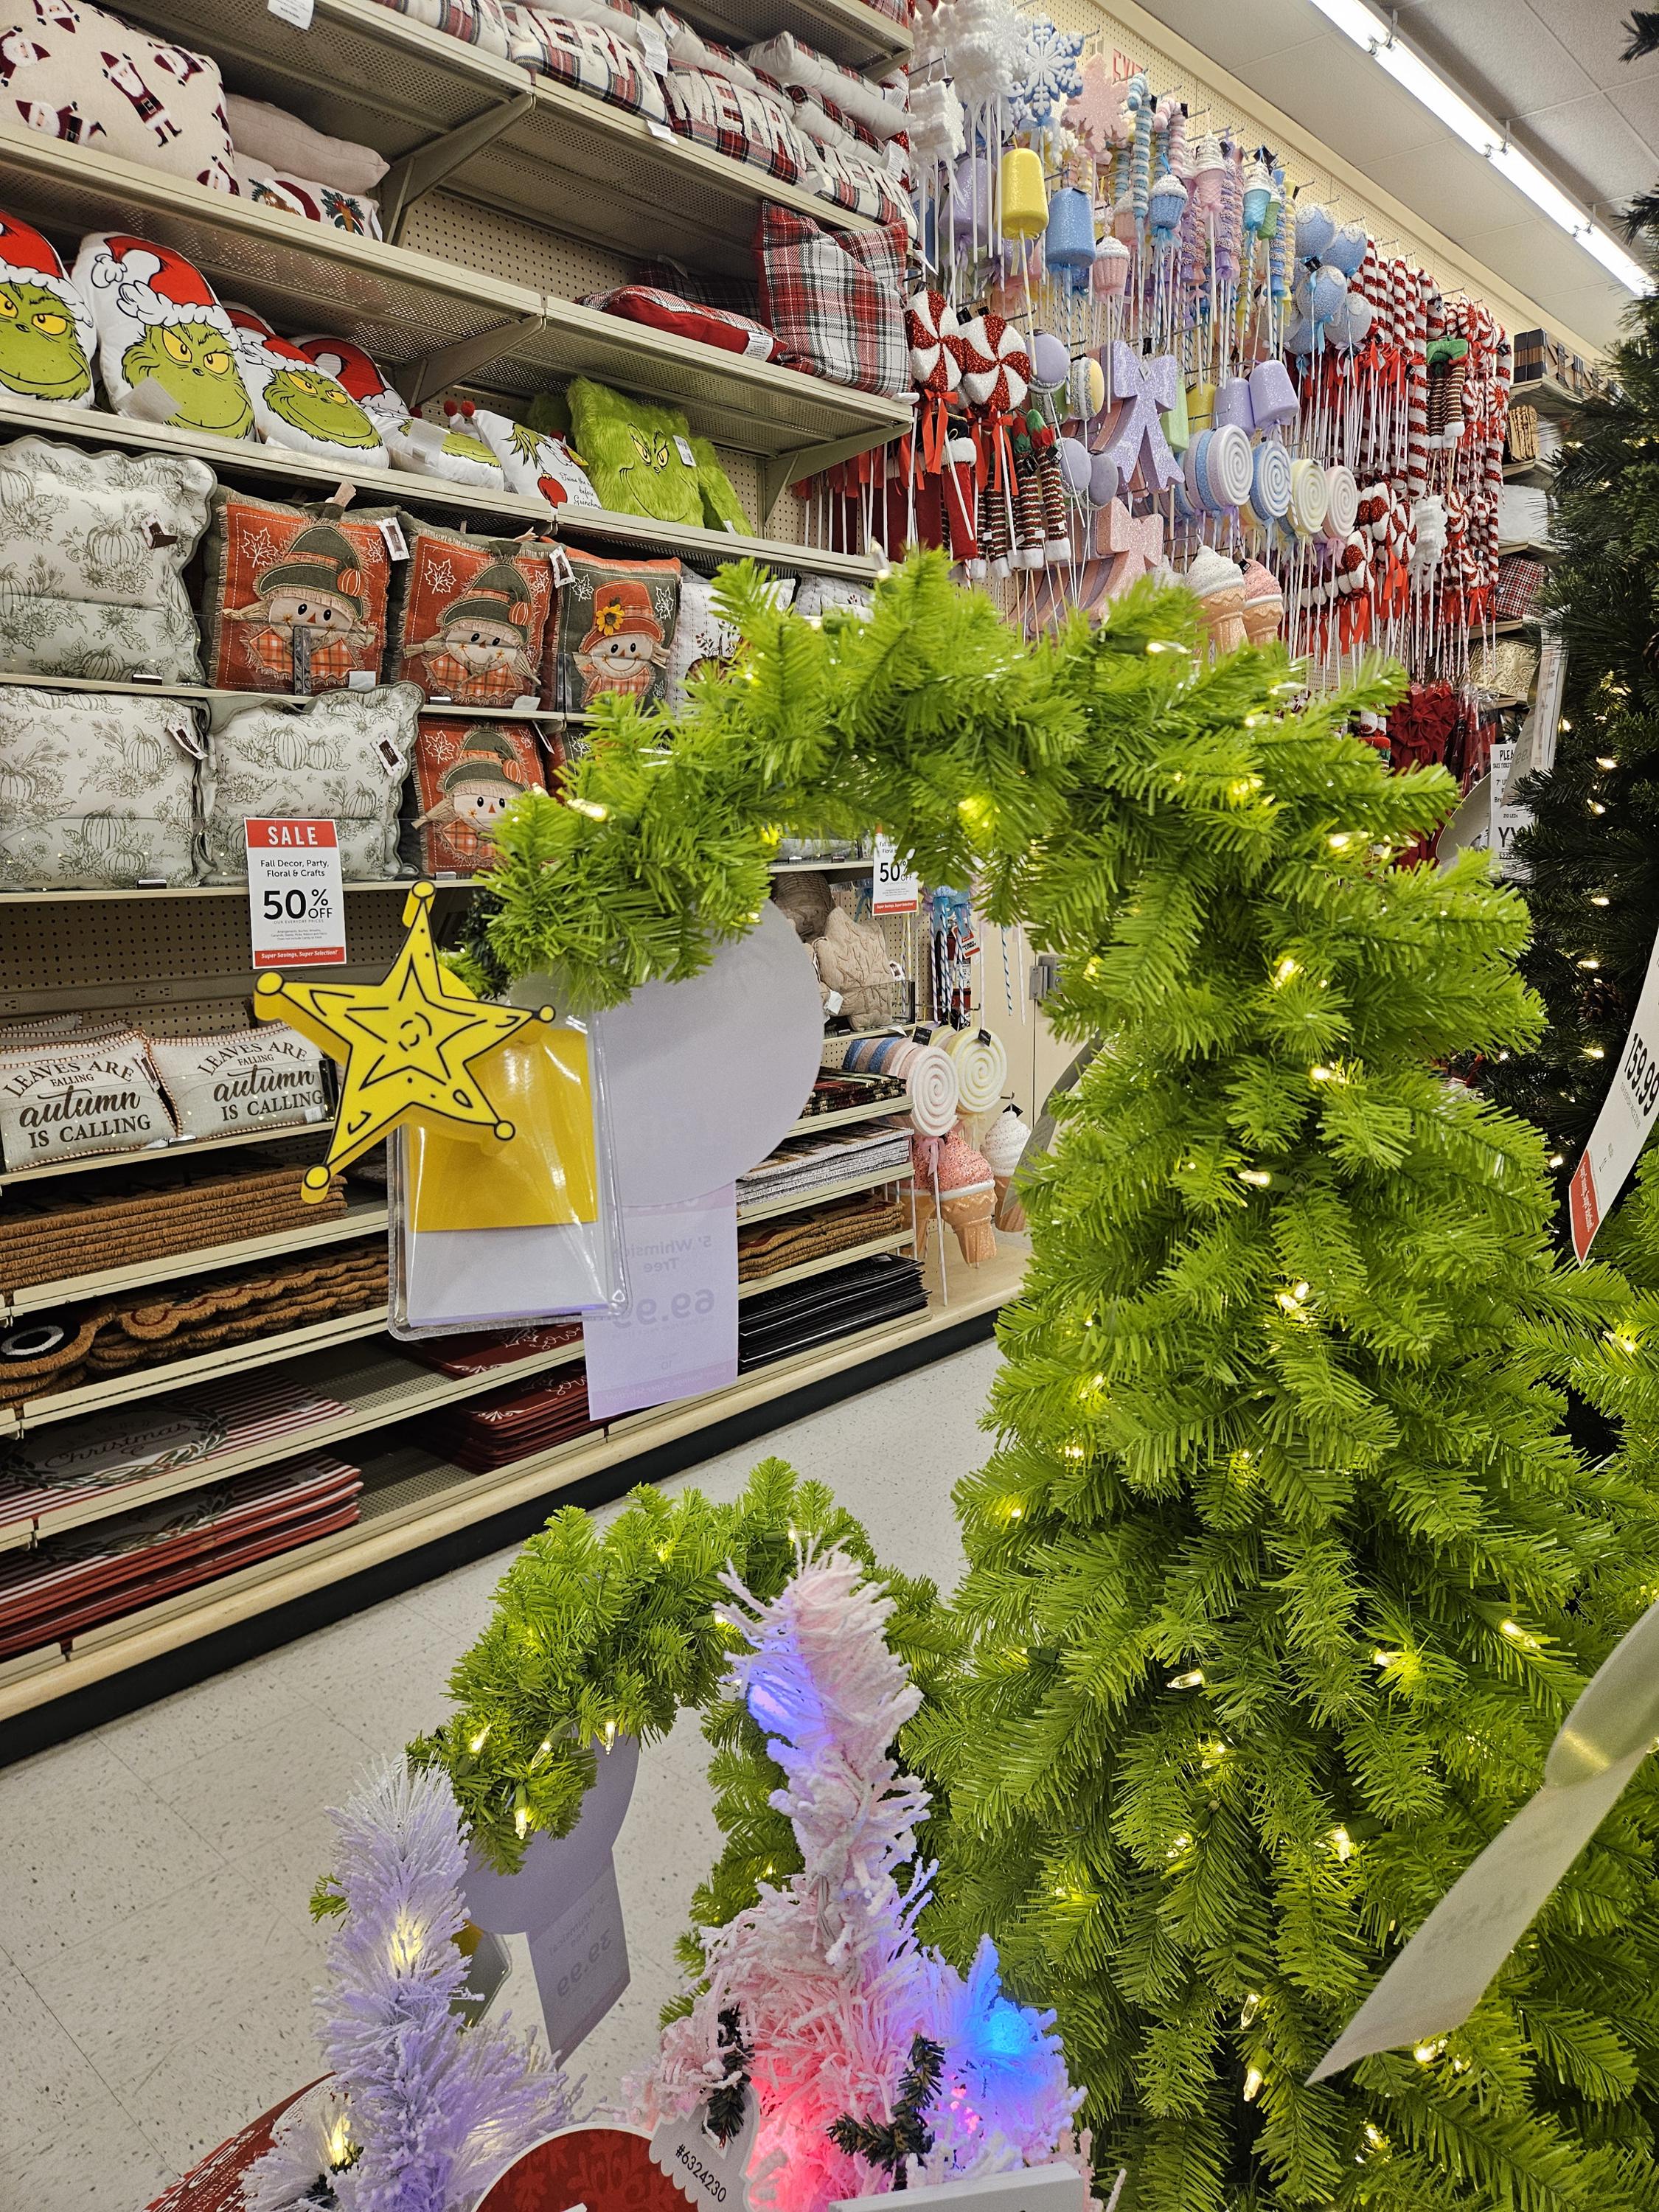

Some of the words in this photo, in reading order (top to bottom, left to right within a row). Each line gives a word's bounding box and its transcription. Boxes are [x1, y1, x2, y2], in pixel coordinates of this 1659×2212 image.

[268, 826, 318, 845] SALE
[260, 860, 275, 868] Fall
[277, 860, 304, 868] Decor,
[306, 860, 329, 869] Party,
[267, 869, 291, 877] Floral
[308, 908, 333, 919] OFF
[261, 952, 276, 960] Super
[197, 1043, 262, 1077] LEAVES
[269, 1041, 307, 1062] ARE
[237, 1054, 274, 1066] FALLING
[1624, 1032, 1659, 1117] 159.99
[2, 1062, 81, 1099] LEAVES
[88, 1060, 135, 1082] ARE
[50, 1073, 94, 1087] FALLING
[213, 1064, 315, 1102] autumn
[19, 1085, 141, 1128] autumn
[221, 1105, 238, 1121] IS
[247, 1090, 324, 1116] CALLING
[28, 1130, 49, 1149] IS
[60, 1114, 151, 1143] CALLING
[675, 2143, 726, 2202] #6324230
